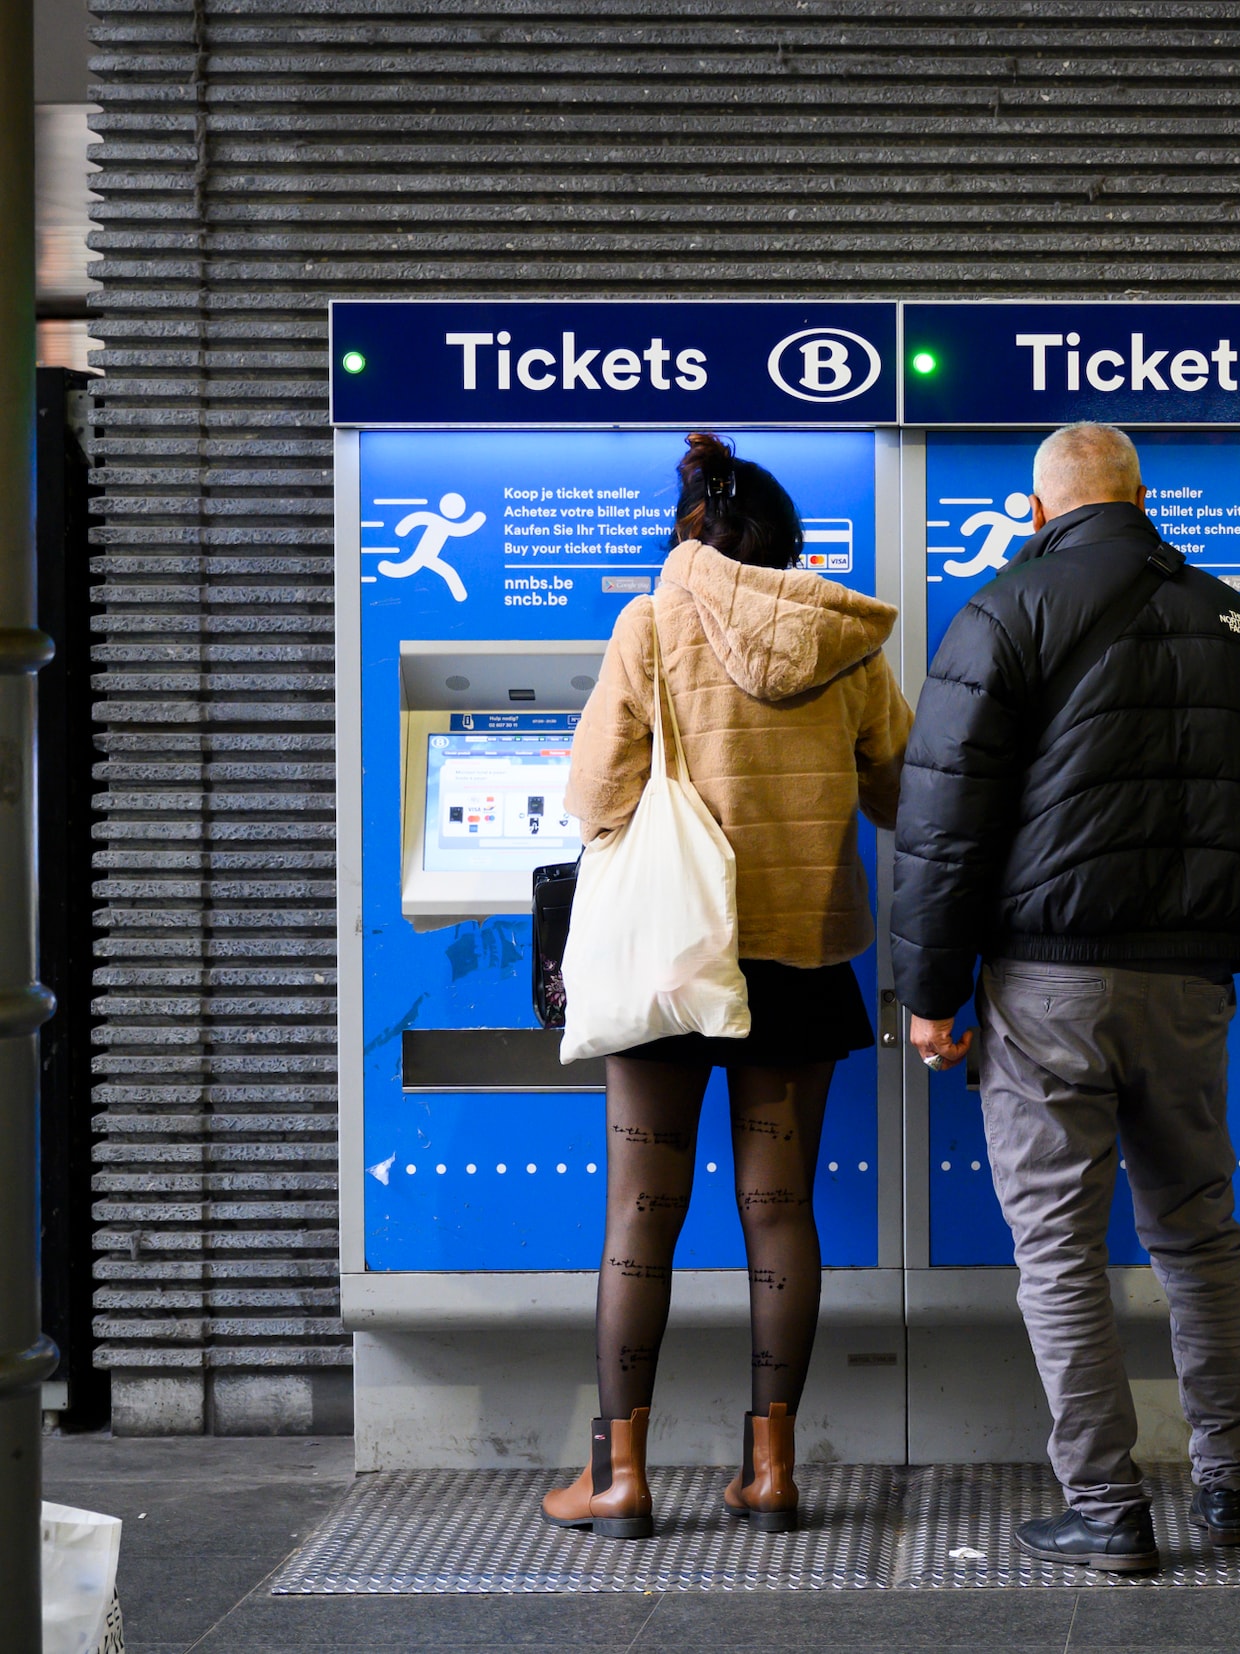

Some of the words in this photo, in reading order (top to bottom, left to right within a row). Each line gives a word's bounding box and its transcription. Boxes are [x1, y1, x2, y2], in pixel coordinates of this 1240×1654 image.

[446, 331, 707, 391] Tickets
[504, 488, 538, 501] Koop
[541, 487, 553, 501] je
[556, 488, 593, 499] ticket
[597, 488, 640, 499] sneller
[1161, 487, 1203, 499] sneller
[504, 506, 557, 517] Achetez
[560, 507, 594, 517] votre
[598, 506, 630, 517] billet
[634, 506, 660, 519] plus
[1161, 506, 1193, 517] billet
[1197, 505, 1223, 519] plus
[504, 524, 550, 535] Kaufen
[554, 524, 573, 535] Sie
[577, 524, 594, 535] Ihr
[598, 524, 638, 535] Ticket
[641, 524, 675, 535] schn
[1161, 524, 1201, 535] Ticket
[504, 542, 528, 556] Buy
[532, 545, 561, 556] your
[564, 542, 601, 554] ticket
[605, 542, 642, 554] faster
[504, 576, 573, 589] nmbs.be
[504, 592, 568, 606] sncb.be
